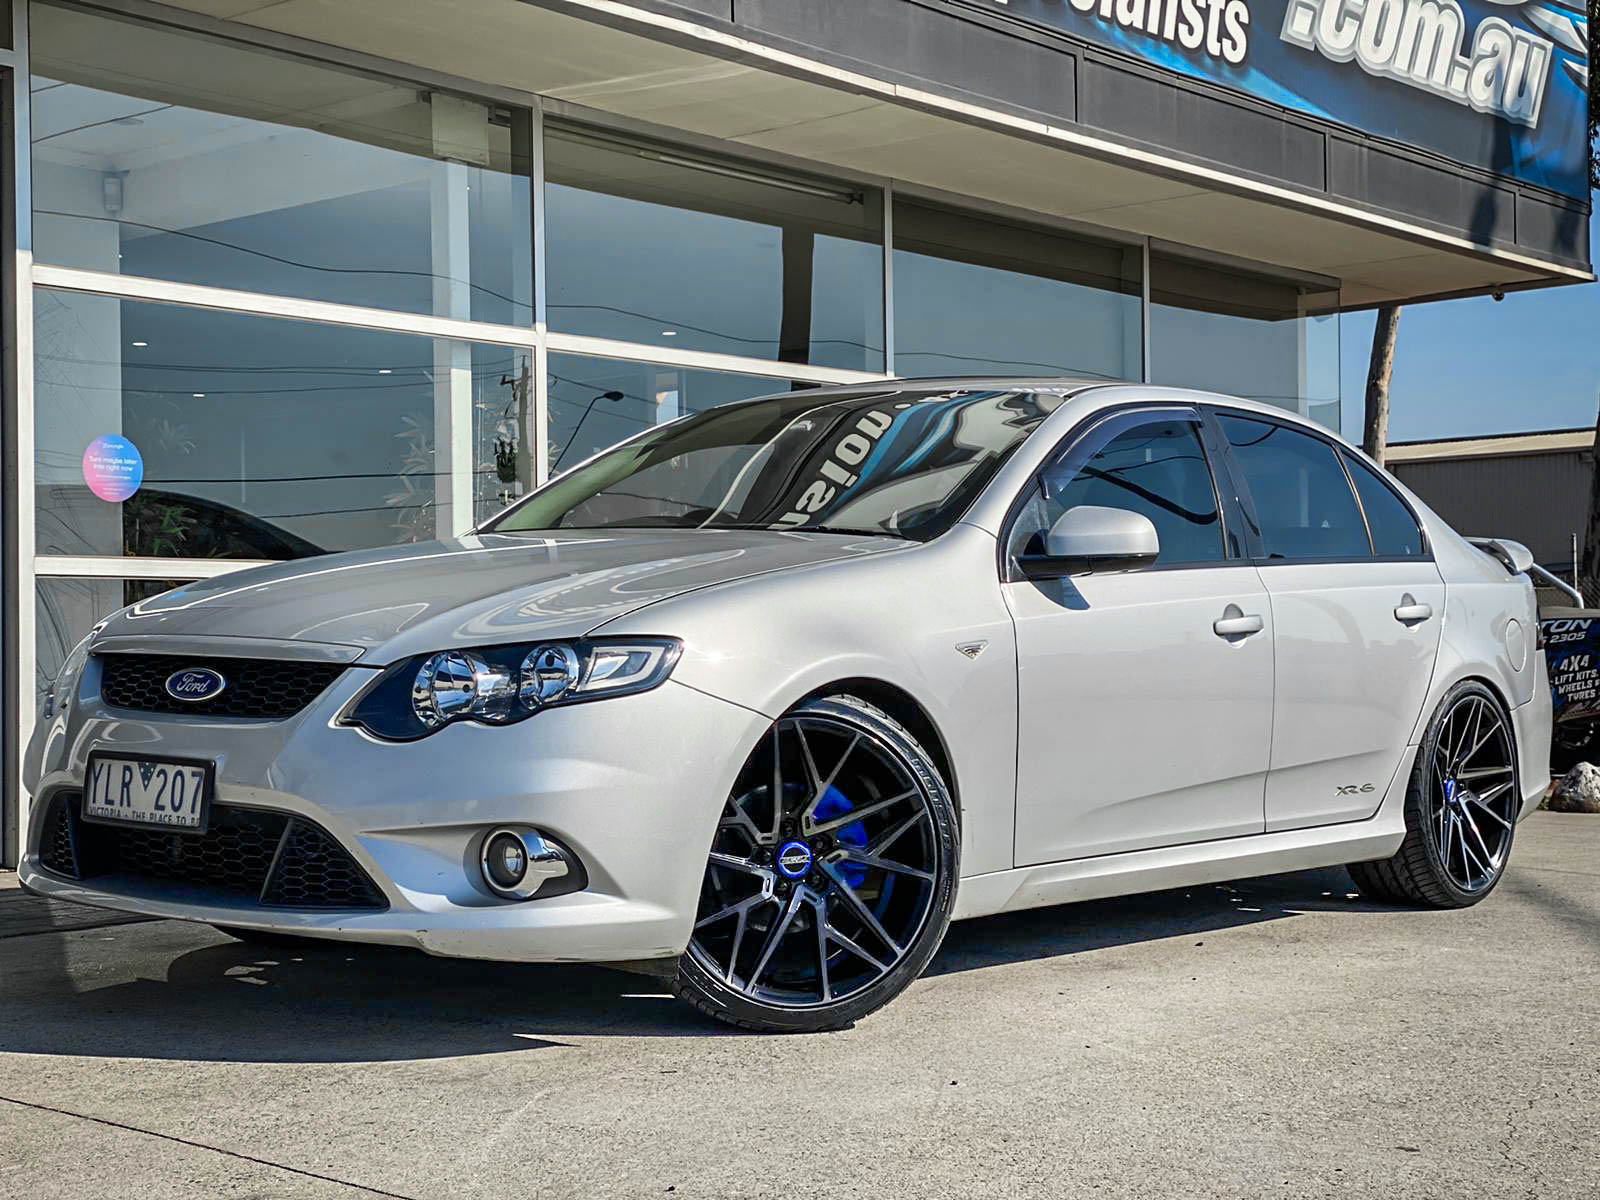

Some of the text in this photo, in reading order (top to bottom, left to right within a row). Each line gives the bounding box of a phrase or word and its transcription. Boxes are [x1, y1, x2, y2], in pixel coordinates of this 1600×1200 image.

[1285, 0, 1550, 123] .com.au
[176, 672, 210, 693] Ford
[1554, 673, 1574, 685] LIFT
[1558, 679, 1593, 695] WHEELS
[92, 762, 204, 815] YLR 207
[1335, 783, 1376, 797] XR6
[176, 815, 187, 825] TO
